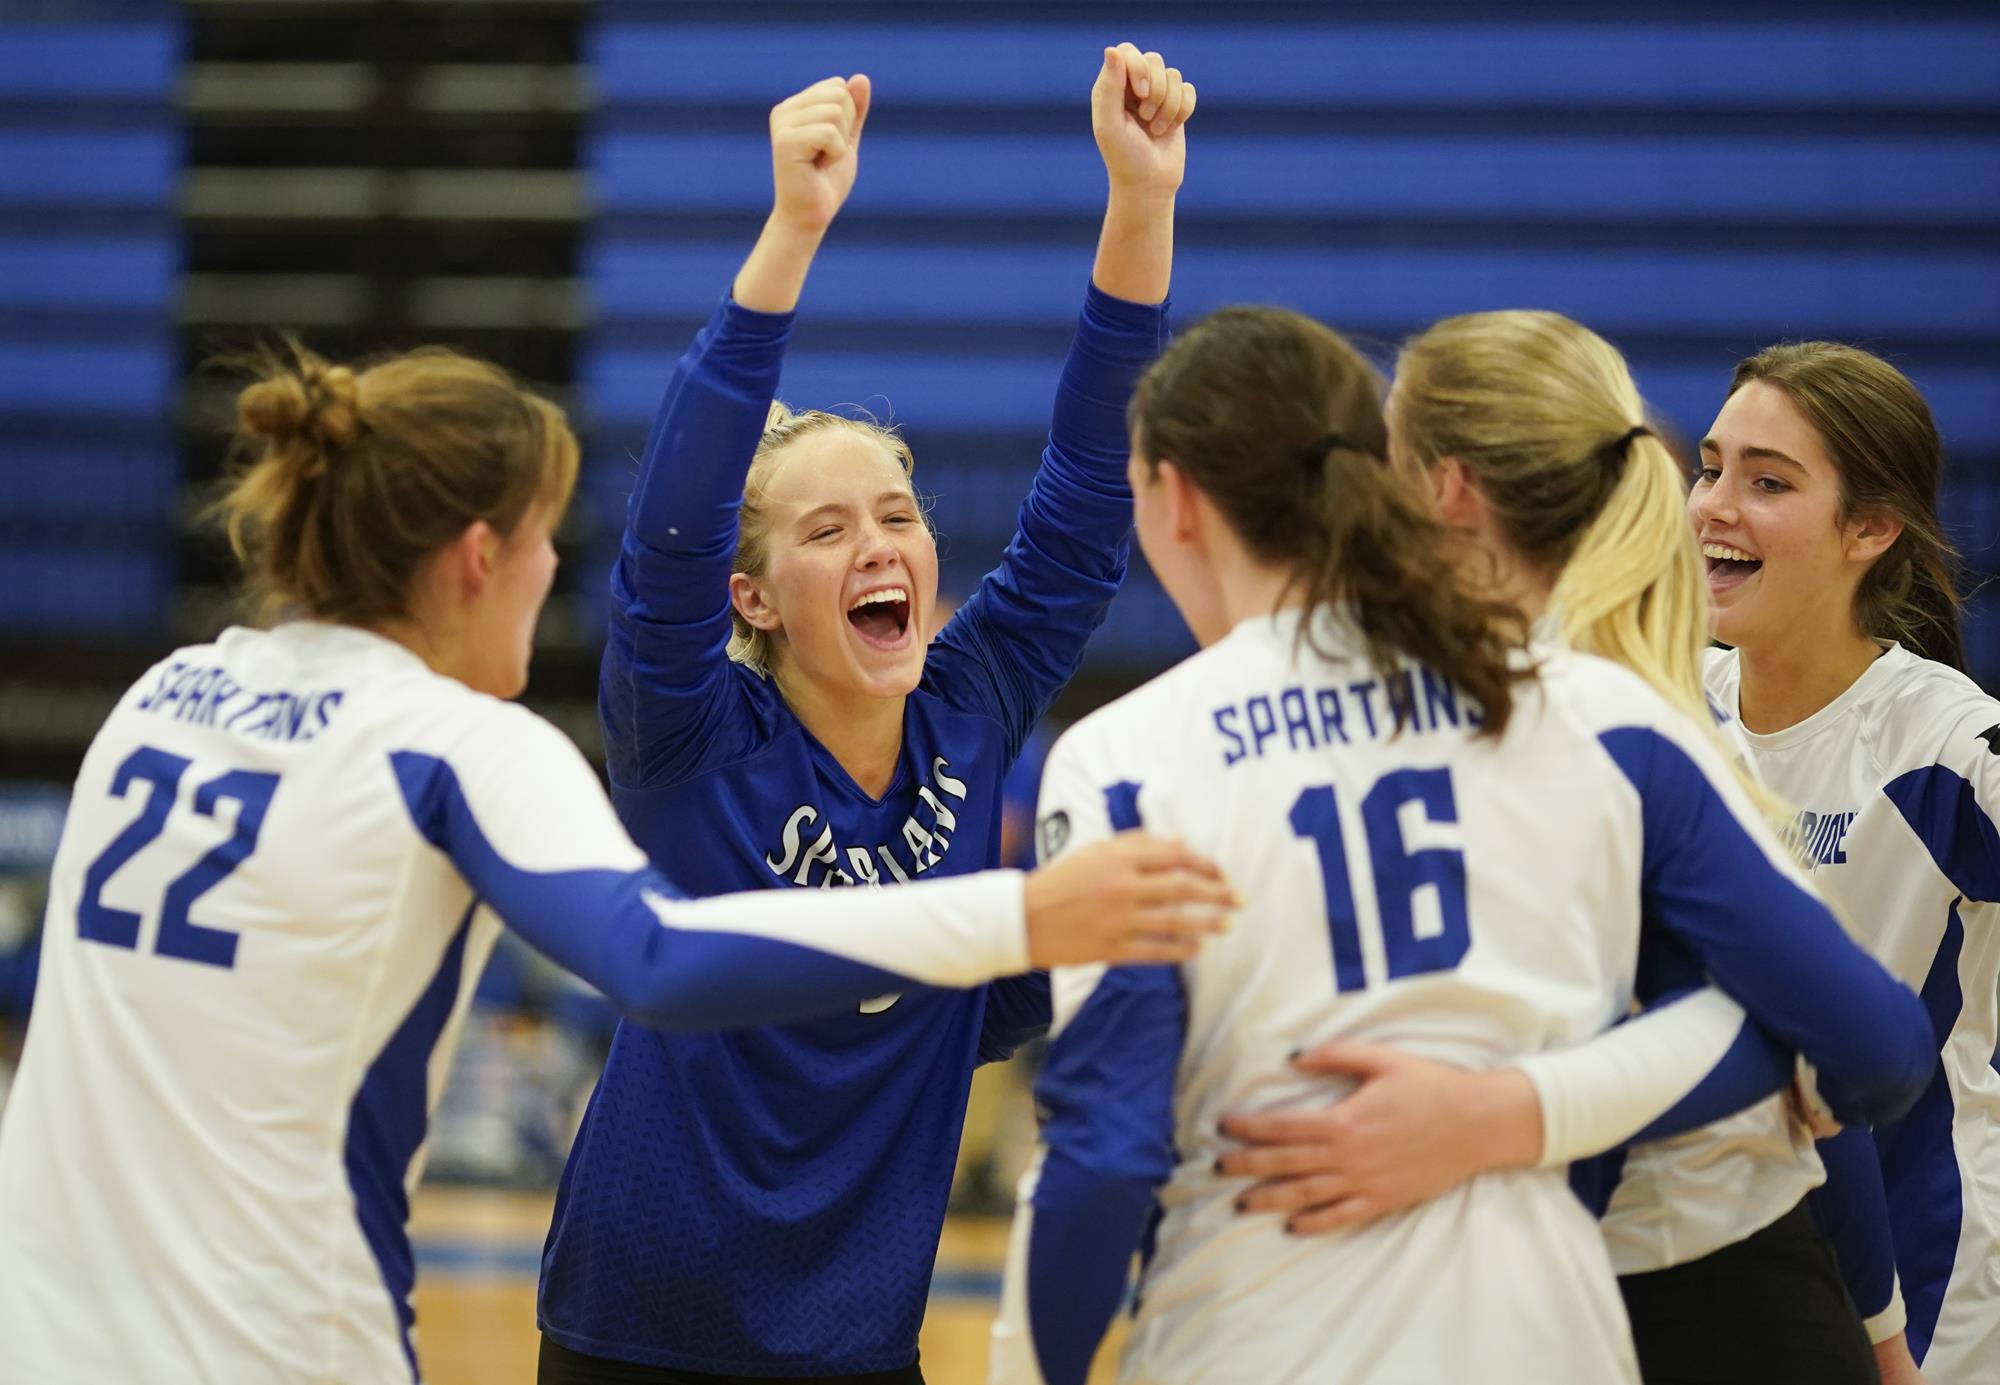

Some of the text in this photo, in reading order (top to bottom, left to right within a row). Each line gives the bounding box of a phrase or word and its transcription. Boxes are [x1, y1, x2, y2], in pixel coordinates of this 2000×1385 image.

[137, 663, 344, 740] SPARTANS
[1213, 664, 1484, 766] SPARTAN
[76, 745, 282, 969] 22
[1288, 764, 1472, 994] 16
